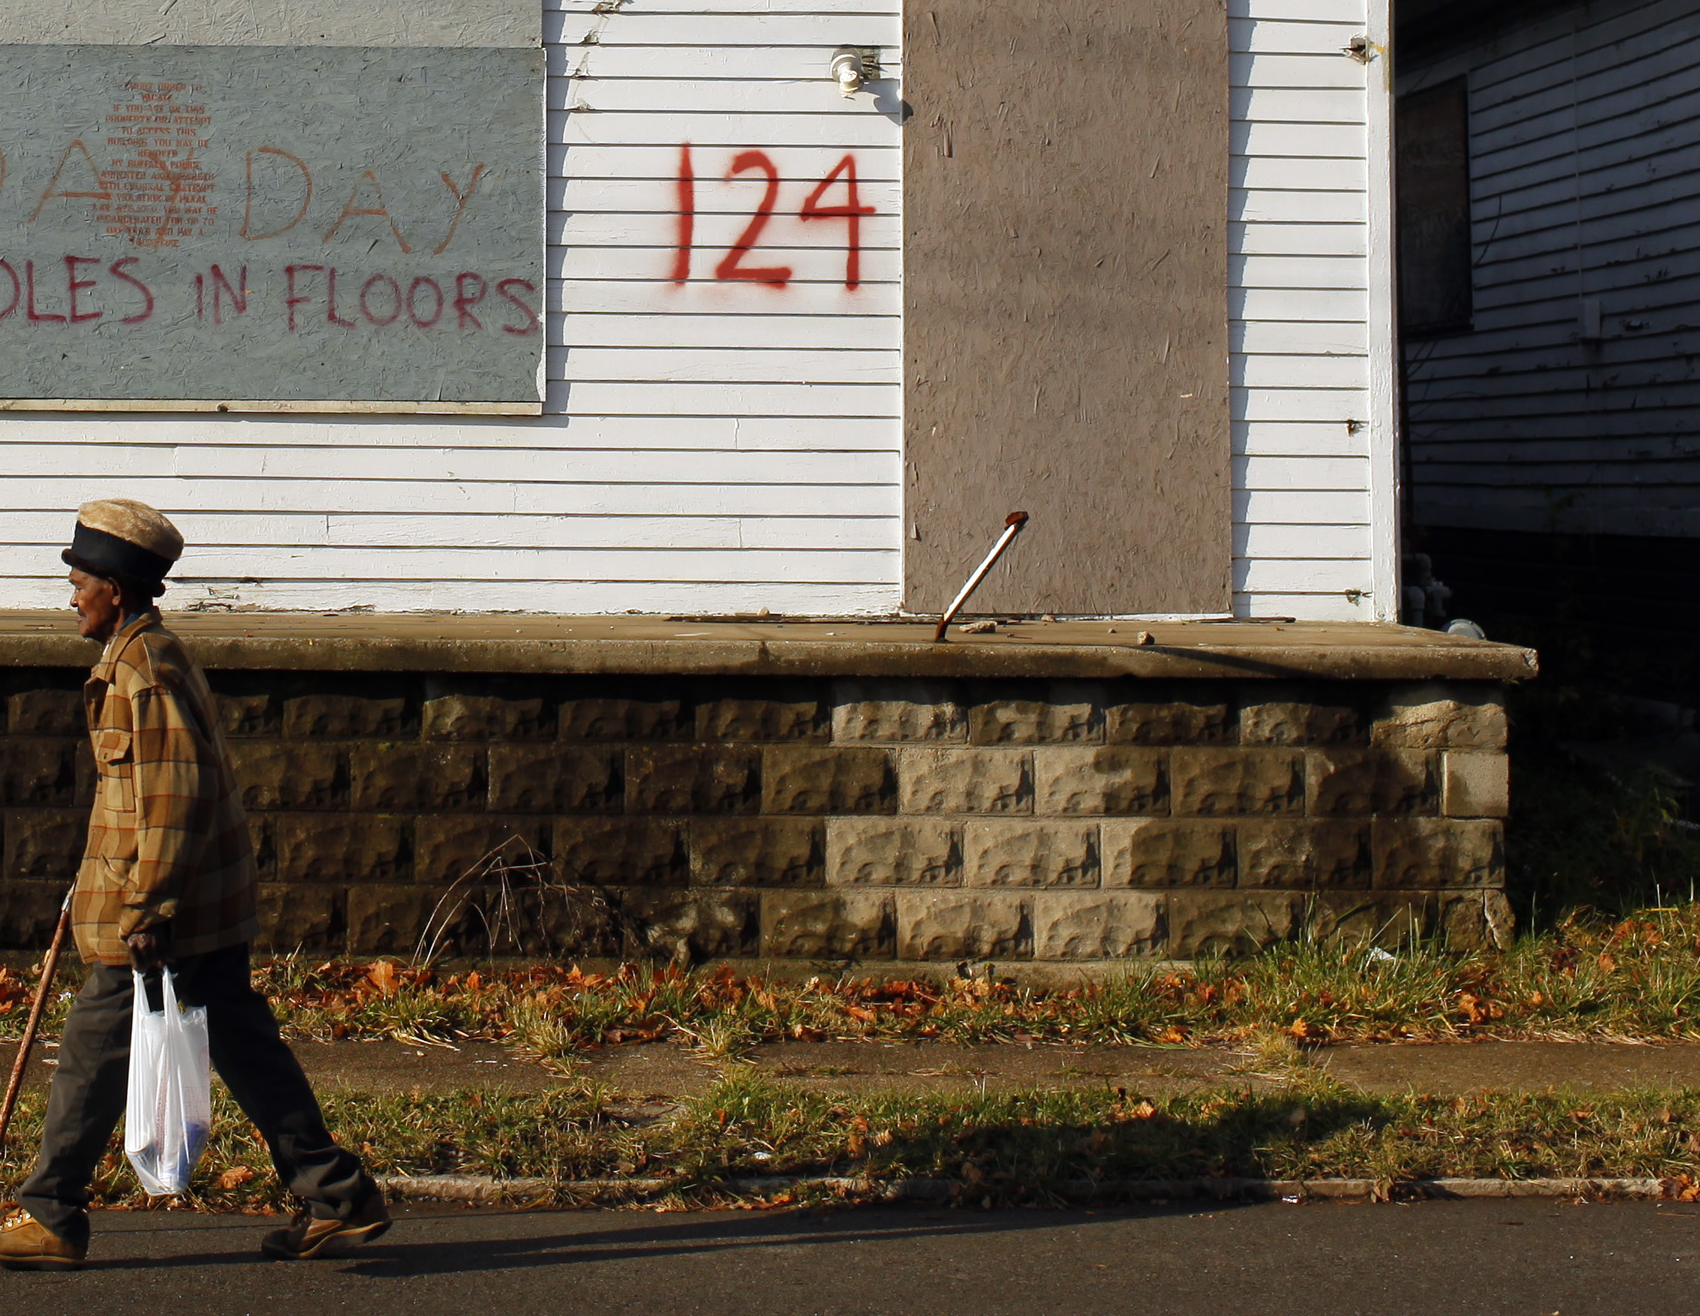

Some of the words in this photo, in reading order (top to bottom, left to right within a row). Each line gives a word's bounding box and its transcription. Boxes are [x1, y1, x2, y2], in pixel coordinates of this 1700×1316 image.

[188, 82, 203, 92] TO
[112, 103, 121, 113] IF
[126, 103, 143, 113] YOU
[147, 104, 164, 113] ARE
[168, 104, 181, 114] ON
[185, 104, 205, 114] THIS
[105, 114, 152, 124] PROPERTY
[155, 115, 168, 125] OR
[173, 115, 212, 125] ATTEMPT
[121, 126, 133, 135] TO
[136, 126, 171, 136] ACCESS
[175, 127, 197, 136] THIS
[154, 138, 173, 147] YOU
[176, 138, 192, 147] MAY
[197, 138, 210, 148] BE
[137, 149, 179, 157] REMOVED
[111, 158, 124, 168] BY
[99, 181, 120, 191] ITH
[179, 193, 207, 203] PENAL
[185, 204, 203, 214] MAY
[206, 205, 218, 214] BE
[203, 215, 215, 226] TO
[673, 142, 876, 291] 124
[196, 263, 249, 324] IN
[284, 263, 542, 336] FLOORS
